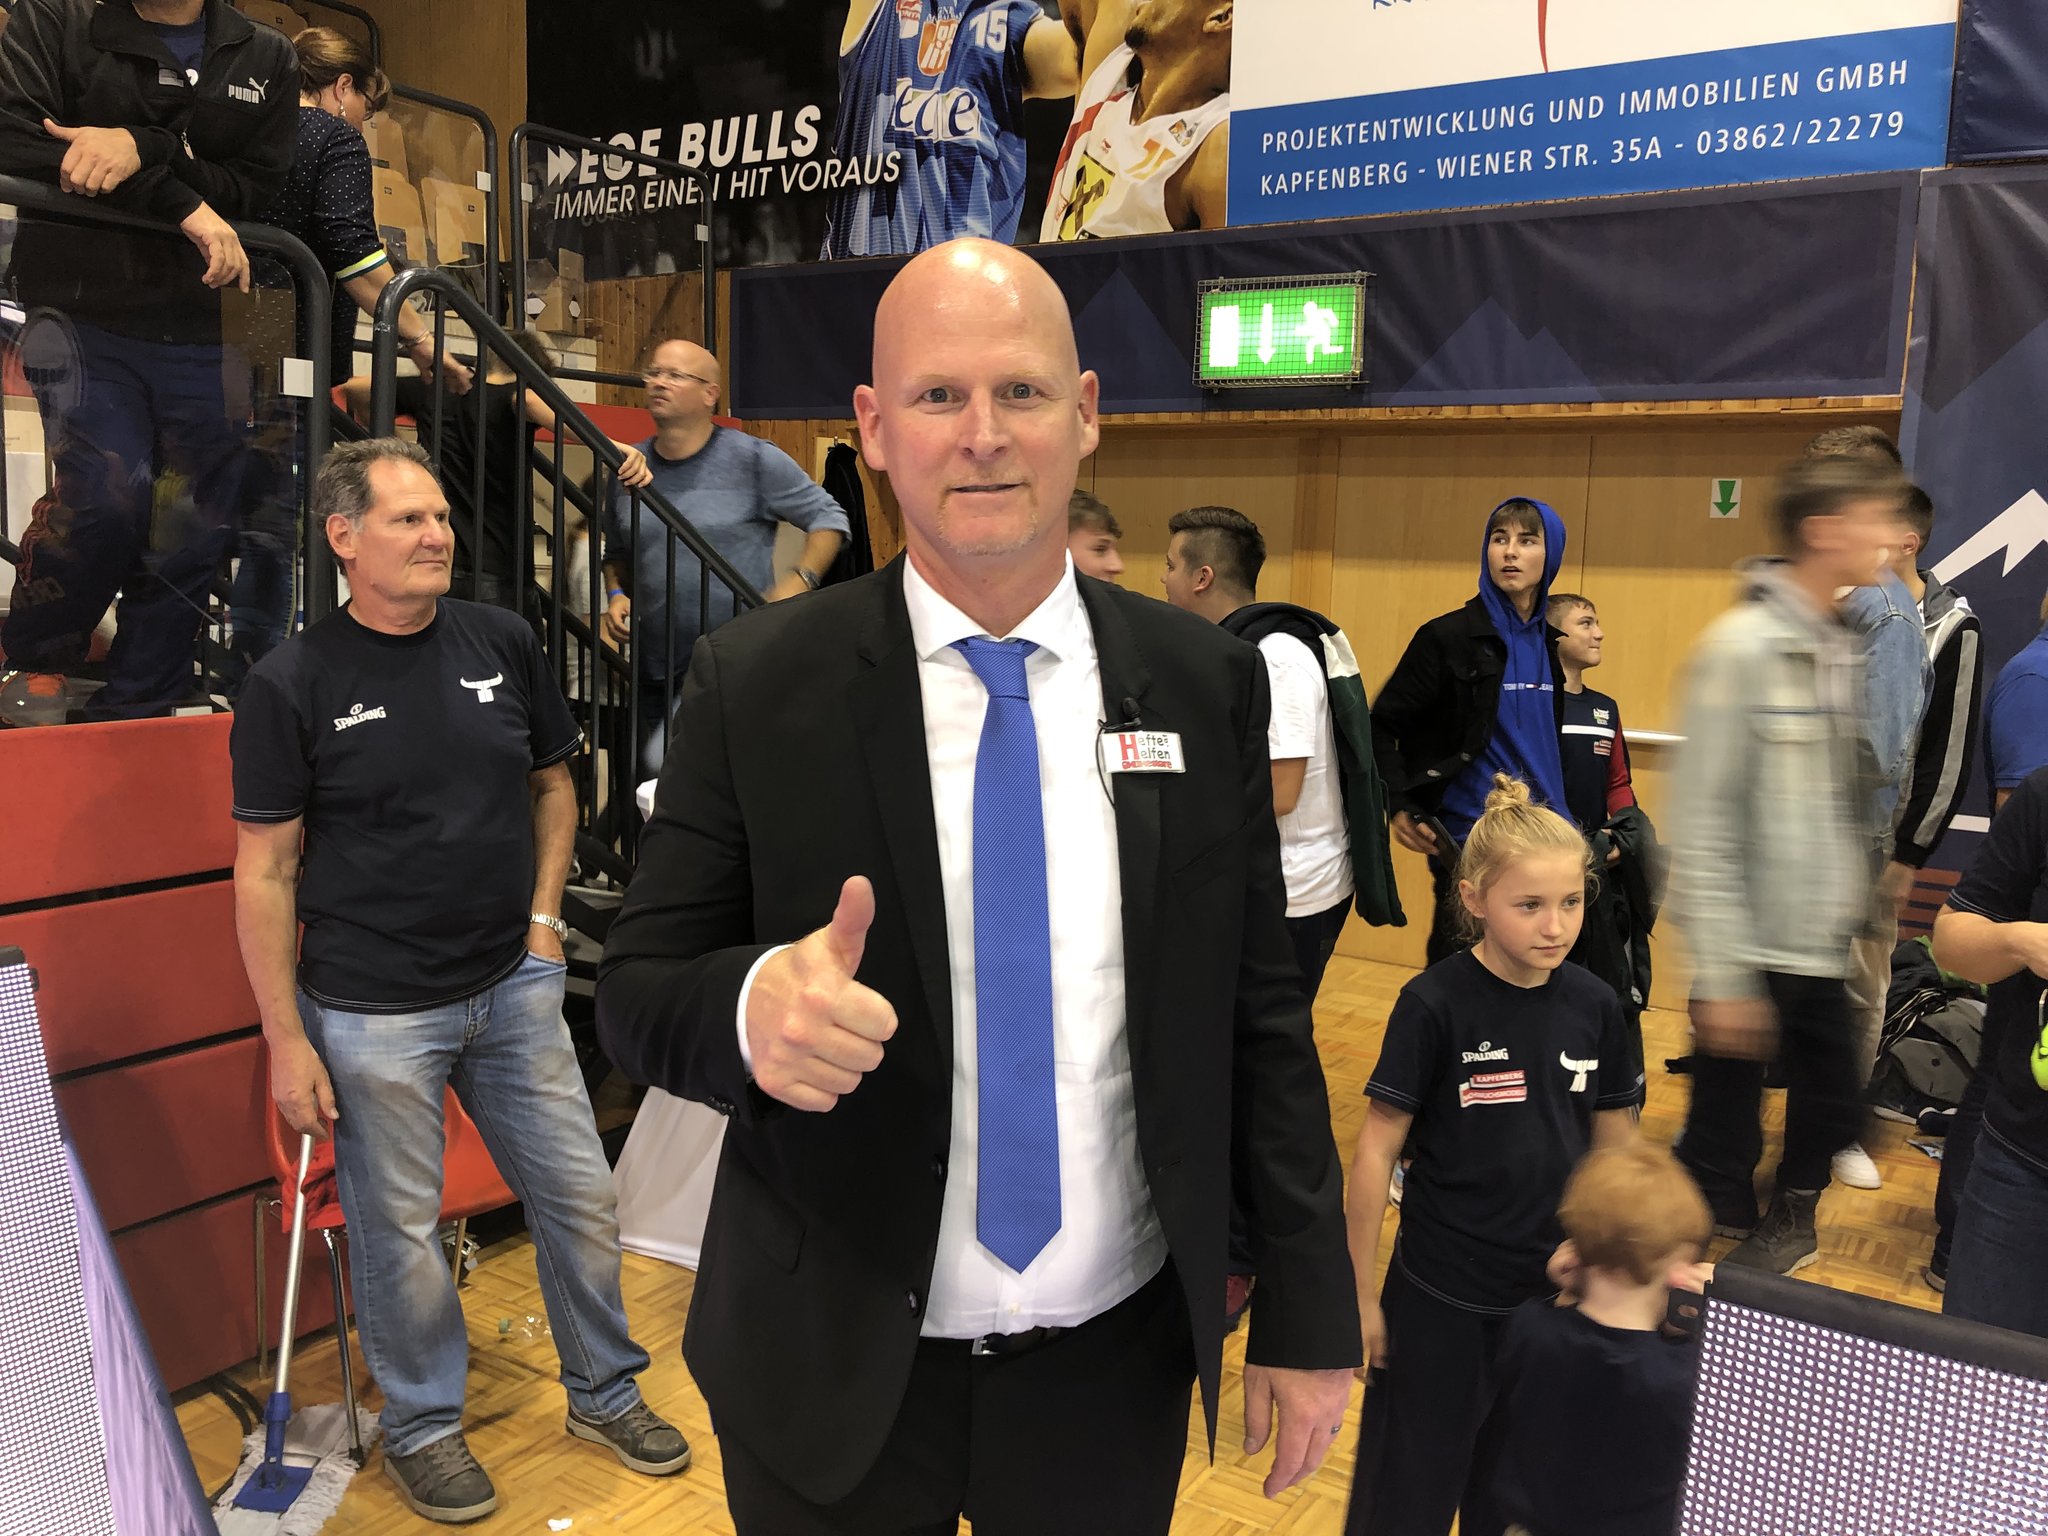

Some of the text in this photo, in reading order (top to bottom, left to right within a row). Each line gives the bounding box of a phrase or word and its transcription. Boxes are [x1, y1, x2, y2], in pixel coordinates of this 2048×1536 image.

[969, 9, 1009, 53] 15
[228, 84, 260, 104] PUMA
[1262, 59, 1908, 154] PROJEKTENTWICKLUNG UND IMMOBILIEN GMBH
[678, 104, 821, 169] BULLS
[1261, 161, 1408, 196] KAPFENBERG
[1436, 149, 1533, 180] WIENER
[1544, 143, 1599, 171] STR.
[1610, 136, 1663, 164] 35A
[1696, 110, 1905, 155] 03862/22279
[554, 184, 636, 220] IMMER
[729, 166, 773, 200] HIT
[780, 150, 901, 192] VORAUS
[333, 706, 387, 731] SPALDING
[1462, 1048, 1509, 1064] SPALDING
